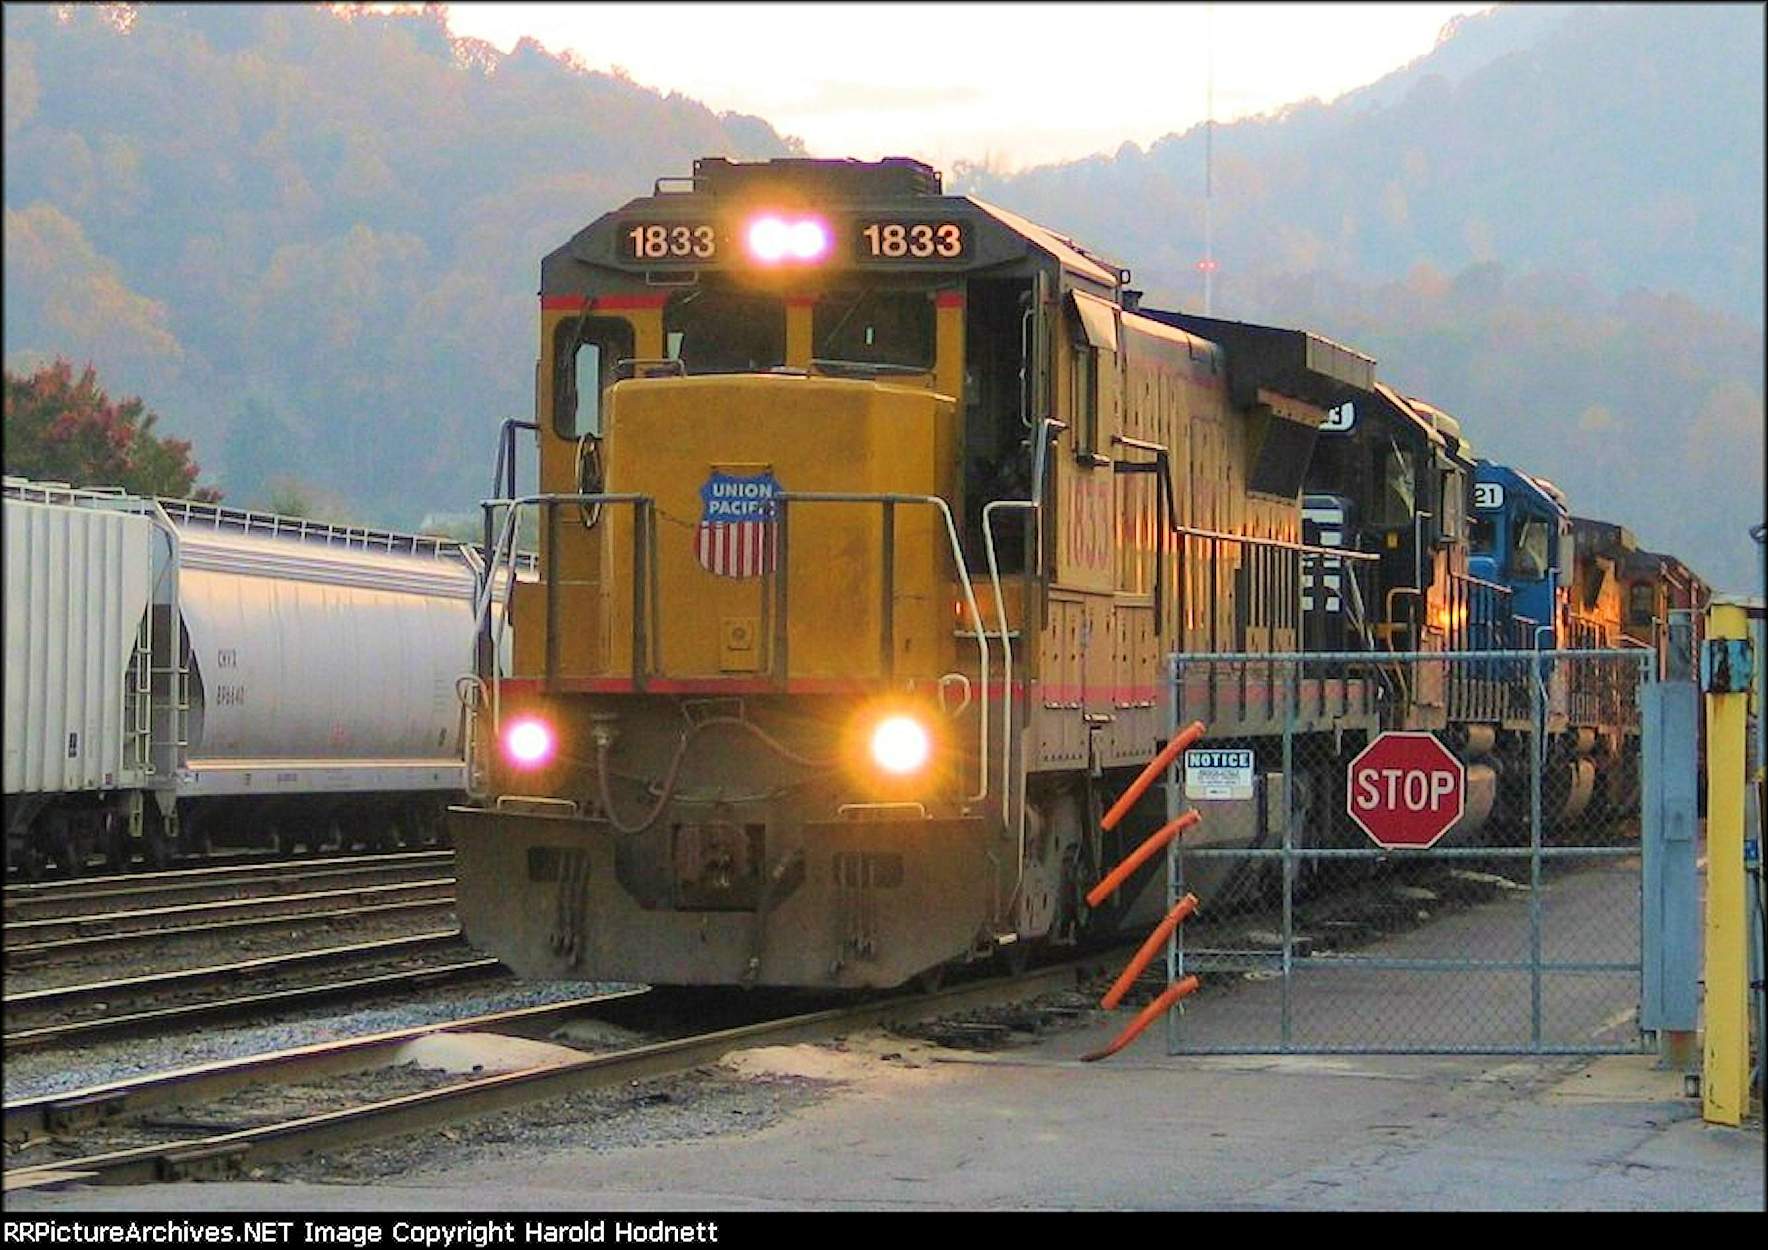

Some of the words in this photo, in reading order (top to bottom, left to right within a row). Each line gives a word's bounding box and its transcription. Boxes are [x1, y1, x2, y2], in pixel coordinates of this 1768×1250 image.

[628, 224, 716, 258] 1833
[863, 223, 962, 258] 1833
[712, 483, 773, 498] UNION
[1474, 487, 1496, 505] 21
[1189, 752, 1249, 767] NOTICE
[1356, 768, 1455, 811] STOP
